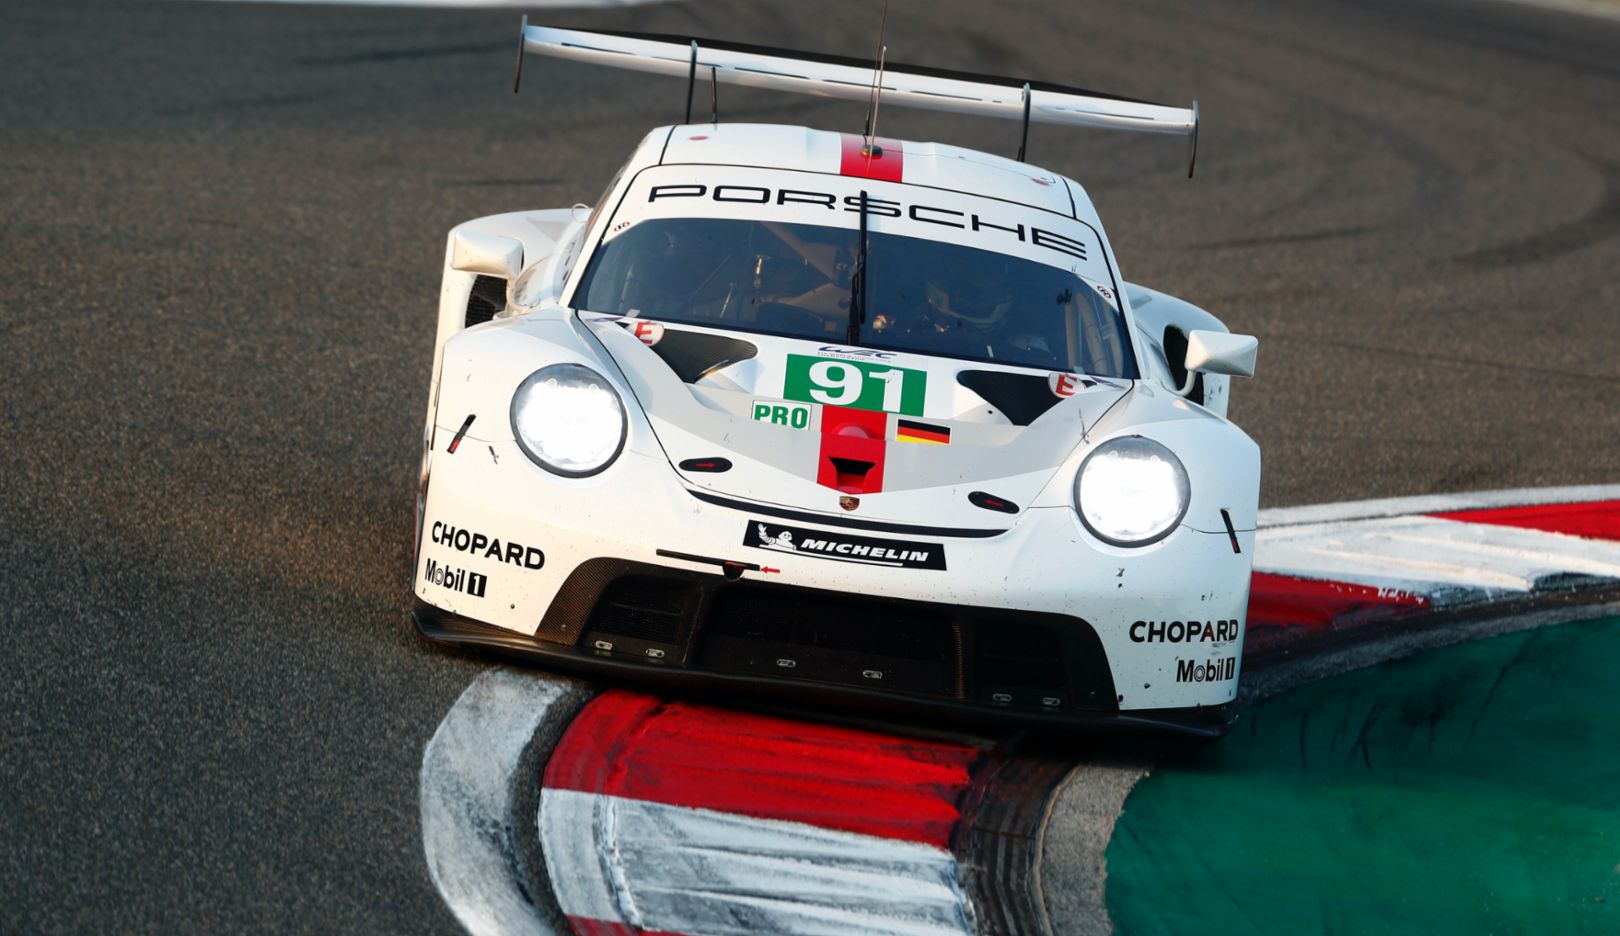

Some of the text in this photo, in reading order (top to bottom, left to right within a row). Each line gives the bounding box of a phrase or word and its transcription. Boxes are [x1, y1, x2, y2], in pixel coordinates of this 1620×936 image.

[648, 185, 1088, 261] PORSCHE
[634, 321, 653, 344] E
[809, 361, 905, 413] 91
[1056, 373, 1078, 396] E
[755, 404, 808, 429] PRO
[432, 521, 545, 570] CHOPARD
[800, 538, 930, 562] MICHELIN
[425, 558, 466, 592] Mobil
[1129, 619, 1239, 643] CHOPARD
[1176, 658, 1224, 683] Mobil
